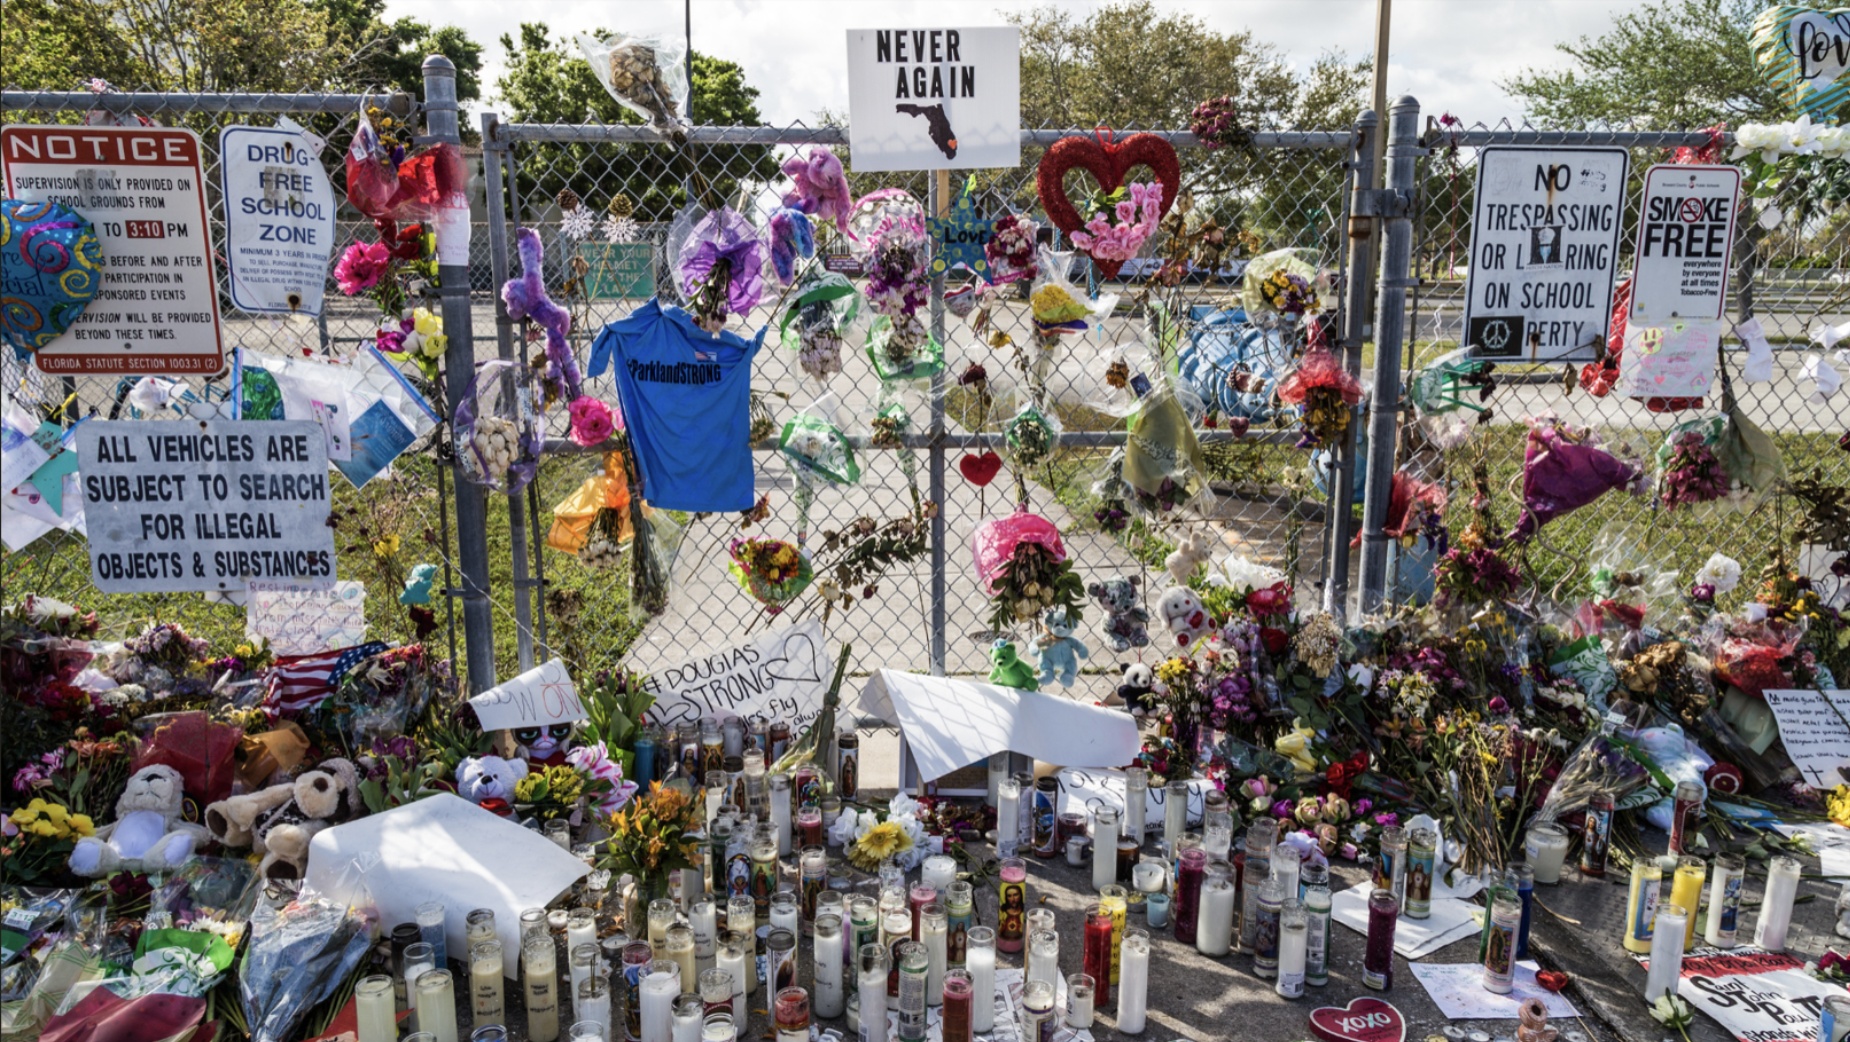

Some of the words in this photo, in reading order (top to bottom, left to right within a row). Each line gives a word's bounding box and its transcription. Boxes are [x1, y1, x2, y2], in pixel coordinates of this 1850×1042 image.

[877, 30, 960, 63] NEVER
[896, 66, 975, 98] AGAIN
[10, 134, 190, 161] NOTICE
[247, 144, 315, 166] DRUG-
[15, 176, 79, 190] SUPERVISION
[84, 177, 94, 190] IS
[98, 178, 121, 190] ONLY
[126, 178, 173, 191] PROVIDED
[177, 179, 191, 191] ON
[259, 172, 313, 193] FREE
[1534, 164, 1571, 191] NO
[47, 195, 86, 208] SCHOOL
[90, 196, 135, 208] GROUNDS
[139, 197, 165, 208] FROM
[241, 197, 326, 221] SCHOOL
[1487, 204, 1613, 231] TRESPASSING
[103, 223, 121, 237] TO
[129, 222, 160, 237] 3:10
[167, 223, 188, 237] PM
[259, 224, 316, 245] ZONE
[1643, 223, 1726, 258] FREE
[110, 256, 146, 267] BEFORE
[151, 256, 169, 267] AND
[174, 256, 202, 267] AFTER
[240, 247, 273, 256] MINIMUM
[283, 250, 305, 258] YEARS
[1482, 243, 1506, 270] OR
[1516, 244, 1608, 270] LRING
[1682, 269, 1690, 277] by
[1683, 260, 1721, 270] everywhere
[105, 273, 170, 284] PARTICIPATION
[174, 274, 183, 283] IN
[1681, 279, 1689, 287] at
[1690, 279, 1699, 287] all
[1700, 279, 1719, 287] times
[151, 290, 186, 300] EVENTS
[1485, 282, 1510, 308] ON
[1521, 282, 1595, 308] SCHOOL
[75, 313, 121, 323] ERVISION
[126, 313, 147, 323] WILL
[152, 313, 164, 323] BE
[168, 313, 211, 323] PROVIDED
[75, 330, 111, 340] BEYOND
[115, 330, 143, 340] THESE
[1526, 321, 1585, 348] PERTY
[43, 358, 81, 369] FLORIDA
[86, 358, 124, 369] STATUTE
[129, 358, 165, 369] SECTION
[204, 358, 218, 370] (2)
[97, 435, 137, 463] ALL
[147, 435, 254, 462] VEHICLES
[267, 435, 309, 462] ARE
[86, 475, 186, 502] SUBJECT
[198, 474, 228, 501] TO
[240, 474, 325, 500] SEARCH
[141, 513, 185, 540] FOR
[195, 513, 281, 539] ILLEGAL
[98, 552, 183, 579] OBJECTS
[193, 552, 206, 578] &
[215, 550, 331, 578] SUBSTANCES
[681, 663, 774, 722] STRONG
[769, 697, 798, 719] fly
[1335, 1012, 1391, 1033] XOXO
